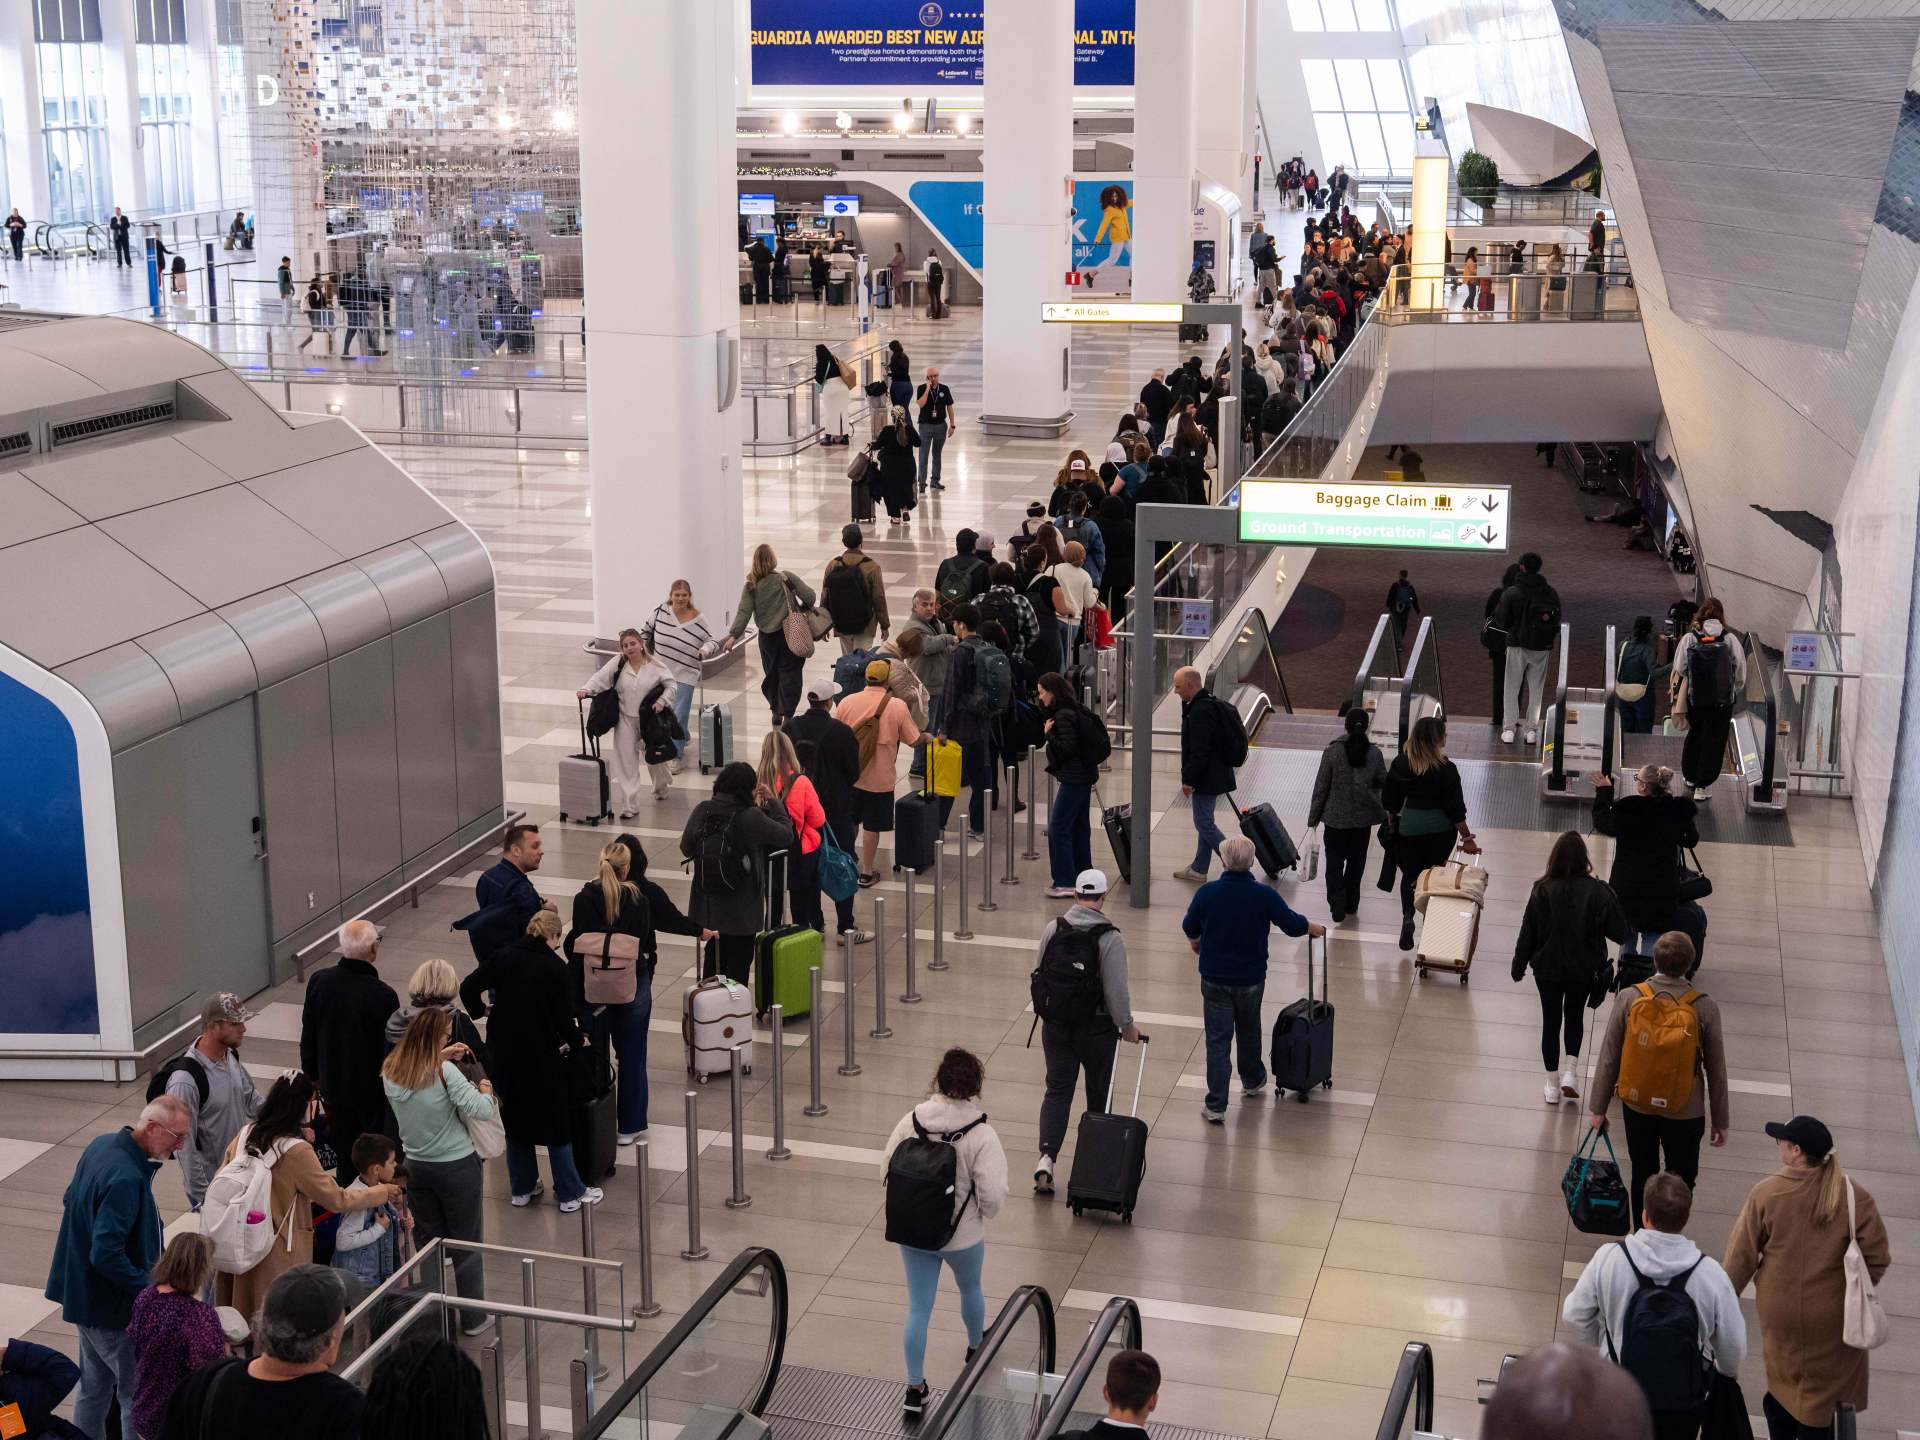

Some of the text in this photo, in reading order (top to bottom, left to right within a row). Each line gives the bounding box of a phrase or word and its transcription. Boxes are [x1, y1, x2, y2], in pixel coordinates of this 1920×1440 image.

[815, 30, 883, 45] AWARDED
[887, 30, 921, 45] BEST
[925, 30, 957, 45] NEW
[1101, 30, 1118, 45] IN
[845, 48, 881, 56] prestigious
[920, 55, 950, 64] providing
[256, 74, 279, 106] D
[963, 203, 974, 215] If
[1074, 307, 1110, 317] All Gates
[1316, 492, 1427, 508] Baggage Claim
[1249, 520, 1426, 541] Ground Transportation
